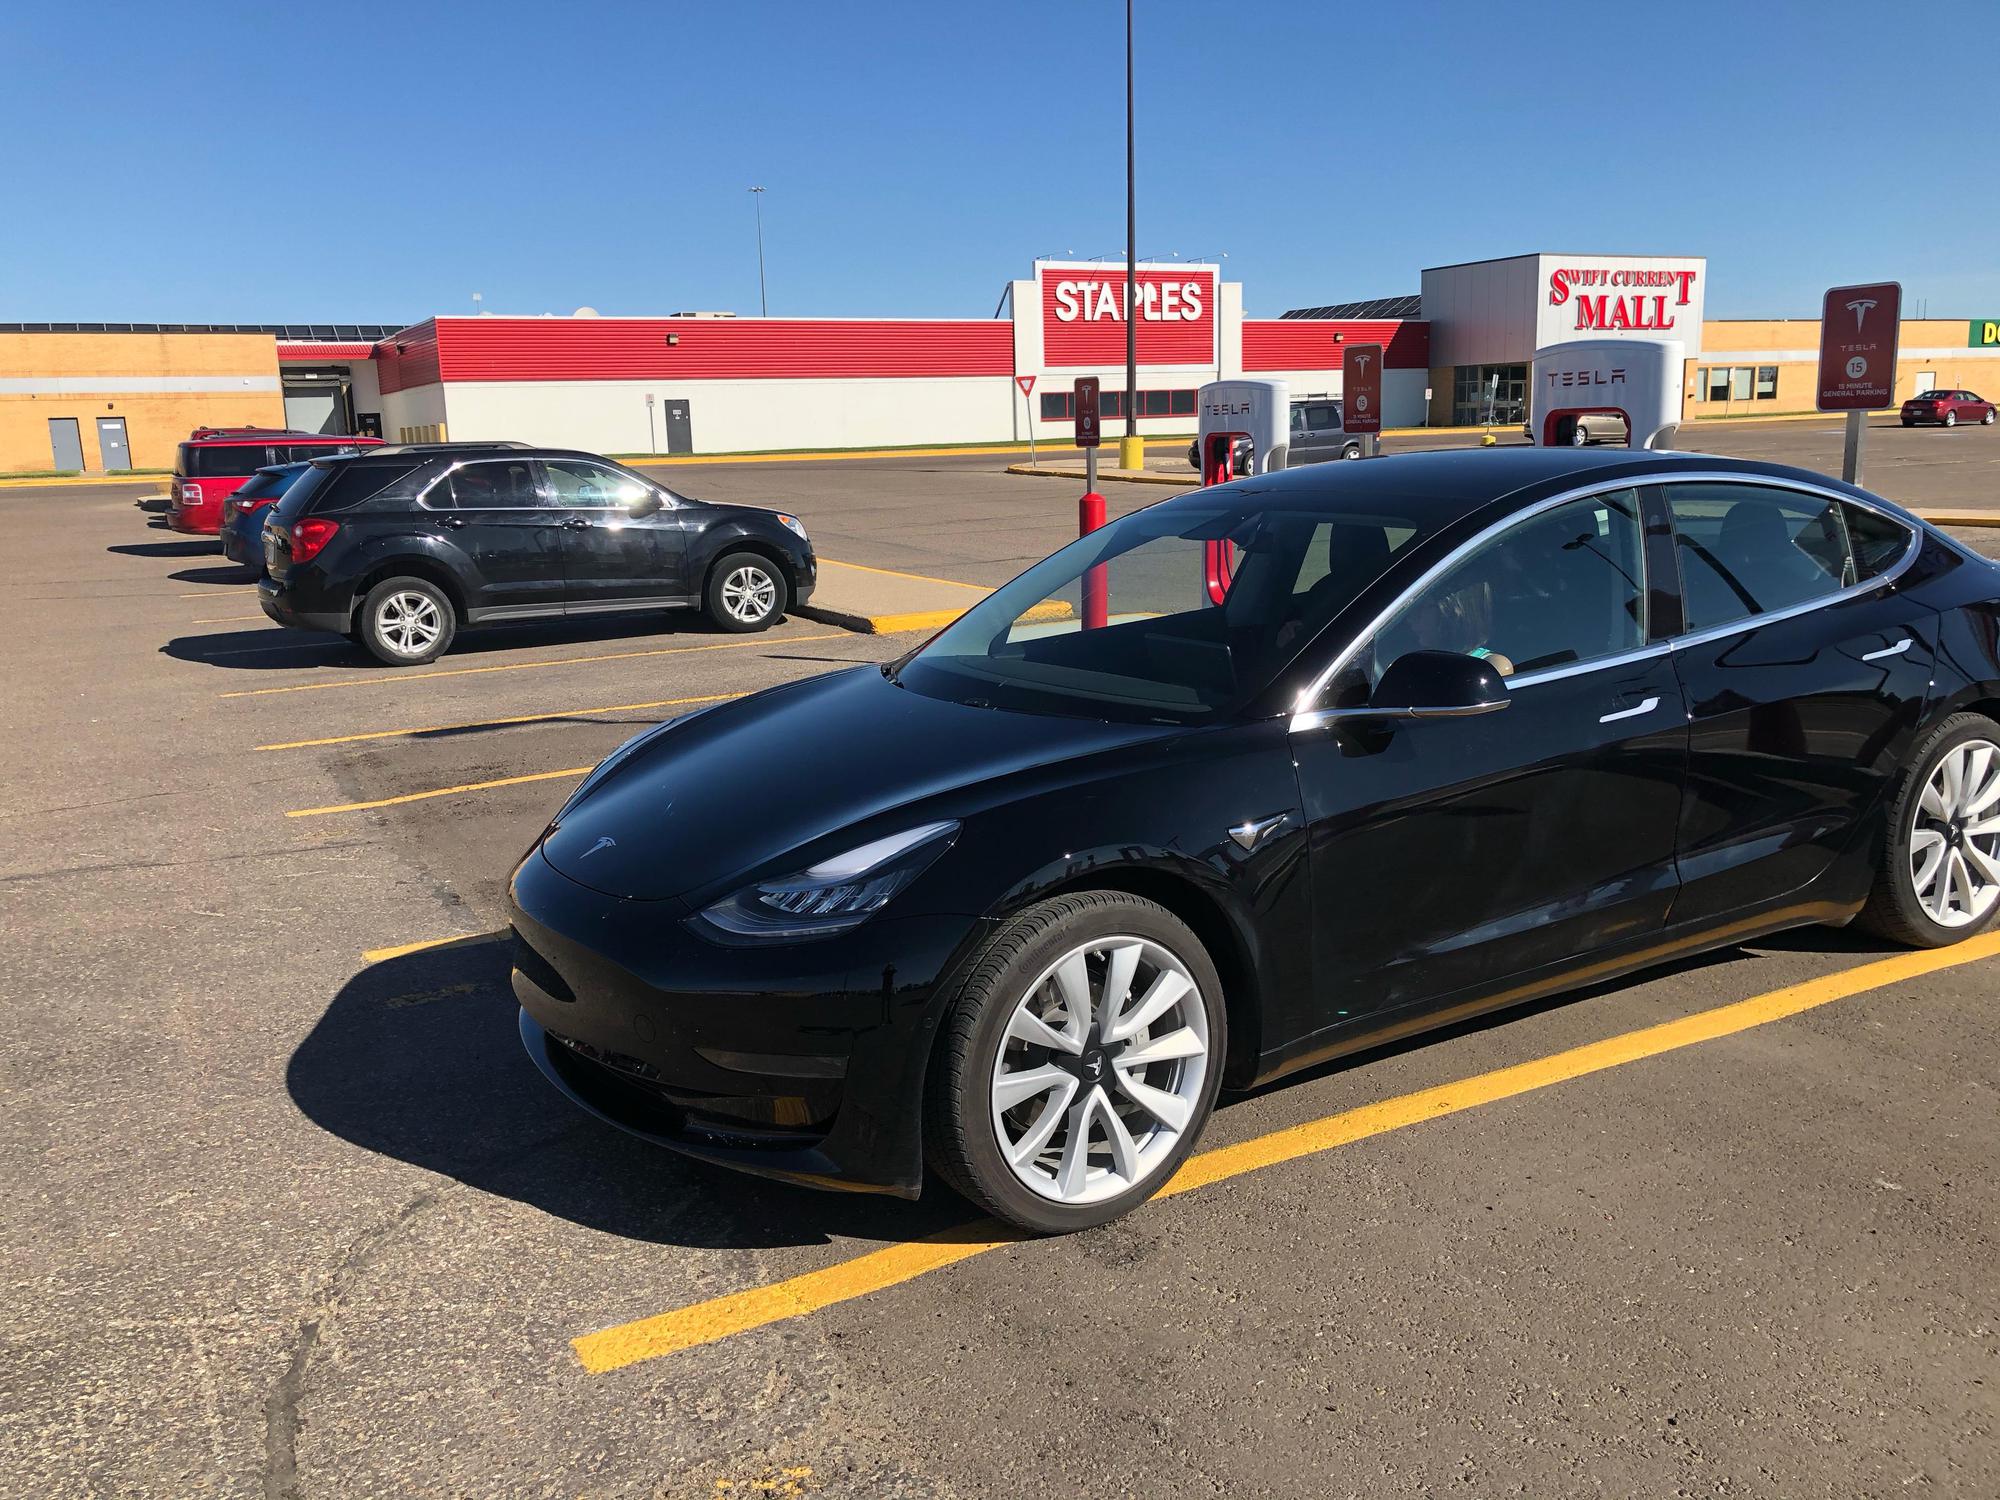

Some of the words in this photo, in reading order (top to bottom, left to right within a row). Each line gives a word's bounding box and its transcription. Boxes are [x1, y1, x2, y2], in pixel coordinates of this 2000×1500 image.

[1550, 269, 1609, 305] SWIFT
[1611, 269, 1696, 305] CURRENT
[1055, 280, 1203, 322] STAPLES
[1574, 294, 1675, 330] MALL
[1840, 343, 1877, 352] TESLA
[1850, 362, 1863, 374] 15
[1548, 368, 1626, 387] TESLA
[1856, 388, 1888, 396] PARKING
[1205, 402, 1250, 416] TESLA
